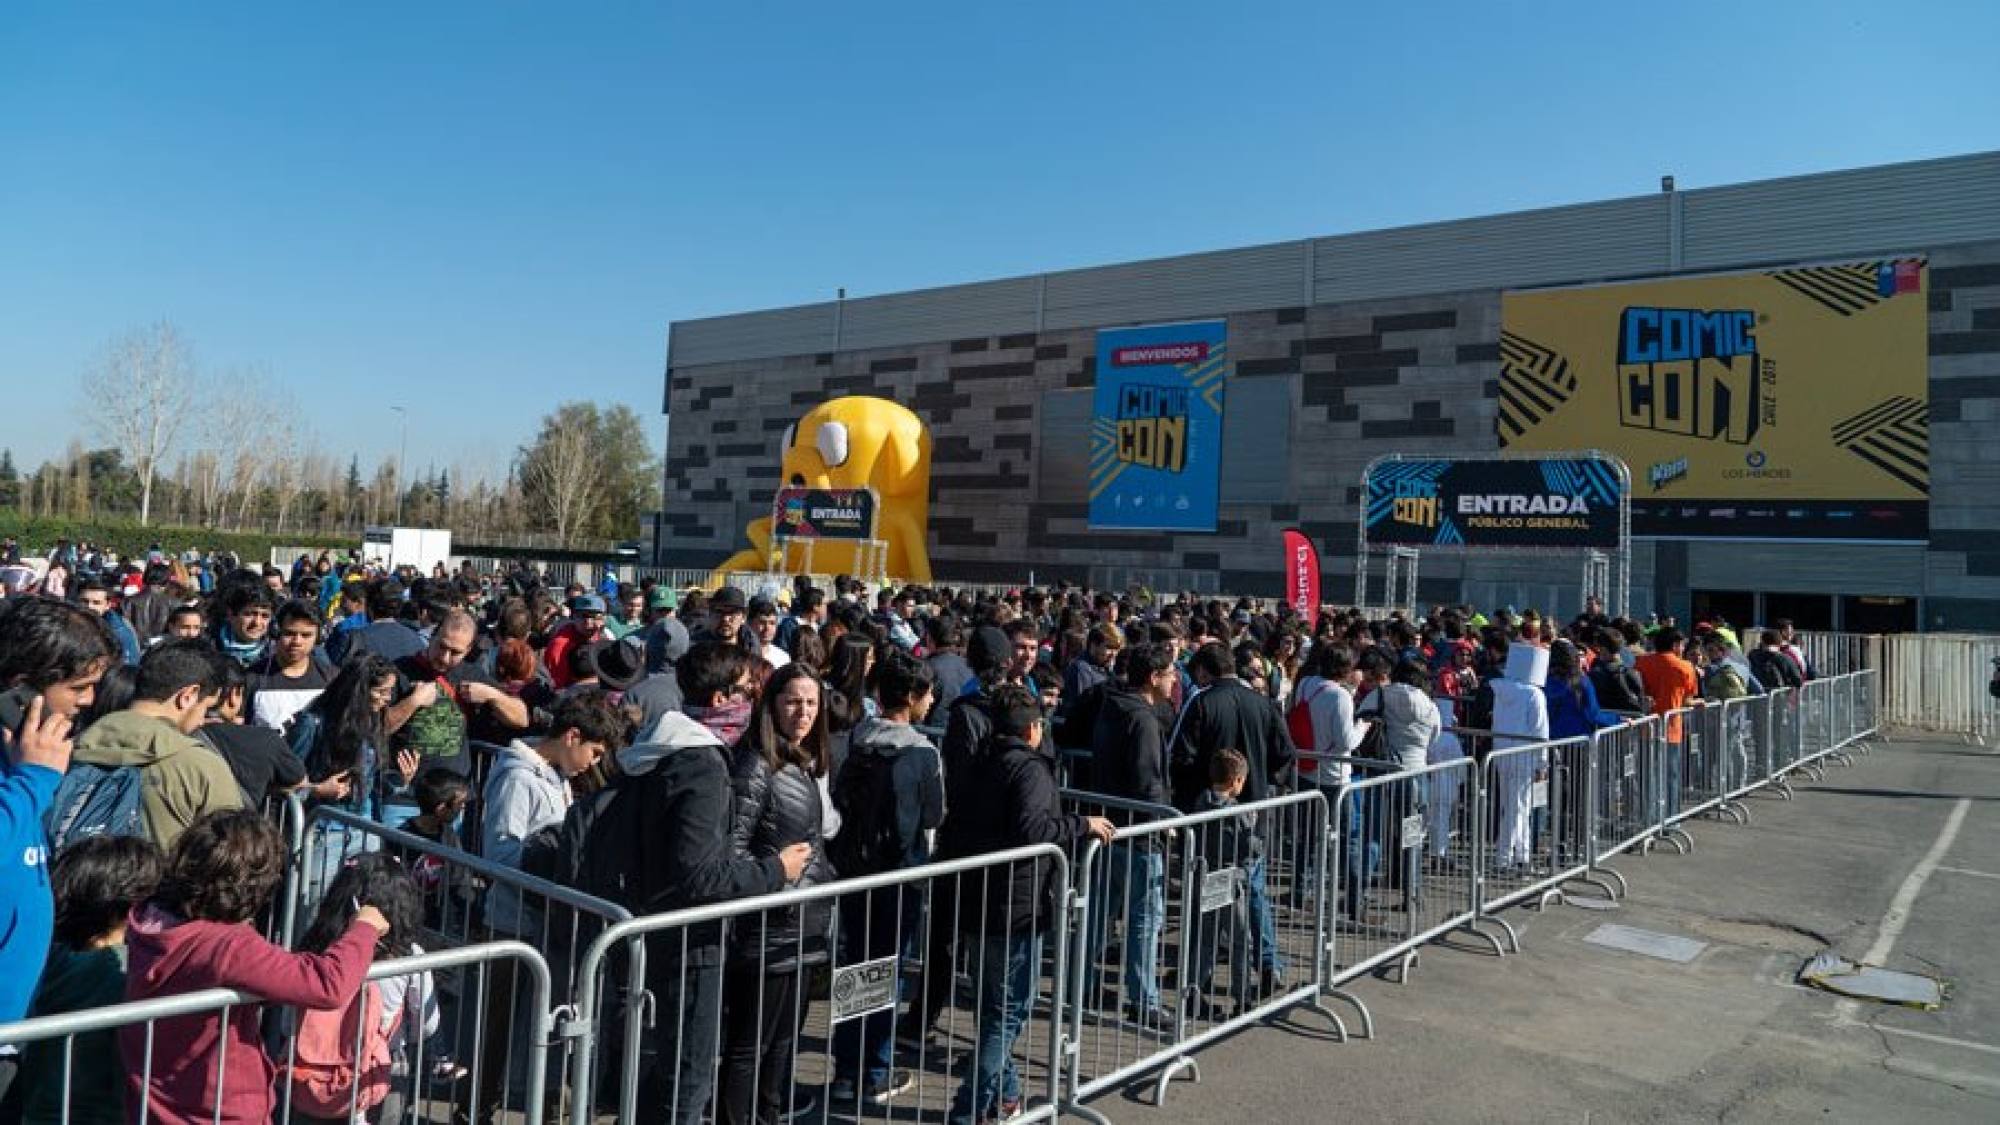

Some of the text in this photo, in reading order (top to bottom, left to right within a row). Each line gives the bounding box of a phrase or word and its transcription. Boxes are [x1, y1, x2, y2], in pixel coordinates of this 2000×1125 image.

[1619, 307, 1756, 364] COMIC
[1119, 348, 1199, 361] BIENVENIDOS
[1617, 353, 1759, 444] CON
[1117, 416, 1188, 473] CON
[810, 508, 861, 519] ENTRADA
[1393, 497, 1437, 528] CON
[1457, 494, 1590, 514] ENTRADA
[1526, 517, 1590, 530] GENERAL
